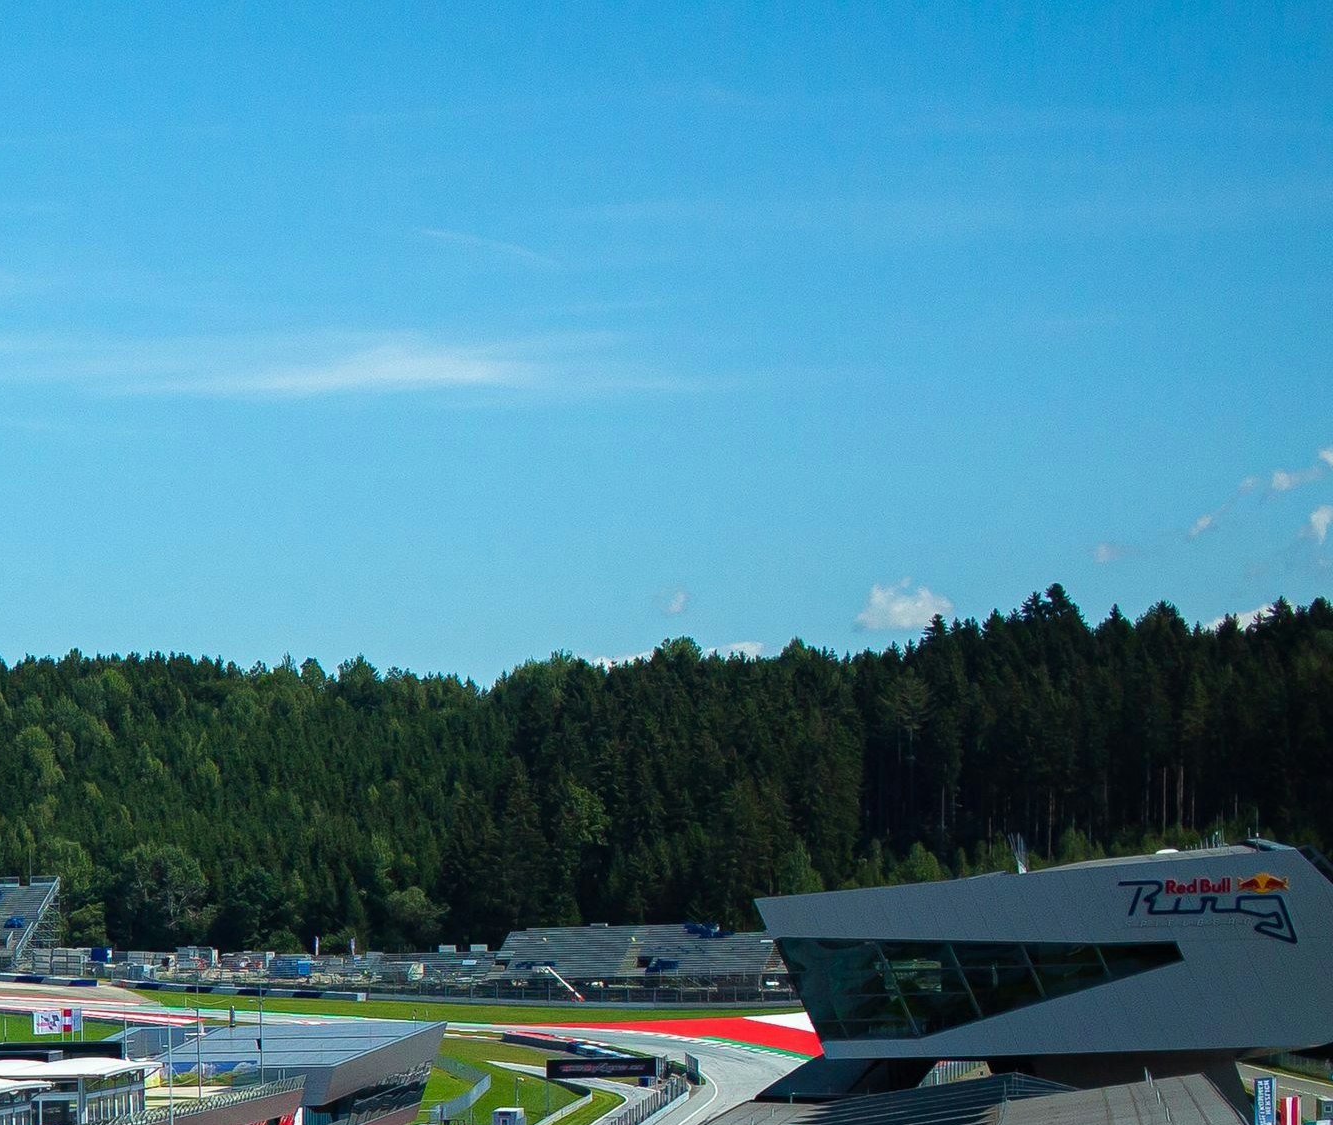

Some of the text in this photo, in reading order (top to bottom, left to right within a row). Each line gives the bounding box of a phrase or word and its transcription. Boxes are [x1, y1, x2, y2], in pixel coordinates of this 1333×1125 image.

[1165, 878, 1231, 895] Red Bull
[1118, 880, 1297, 944] Ring
